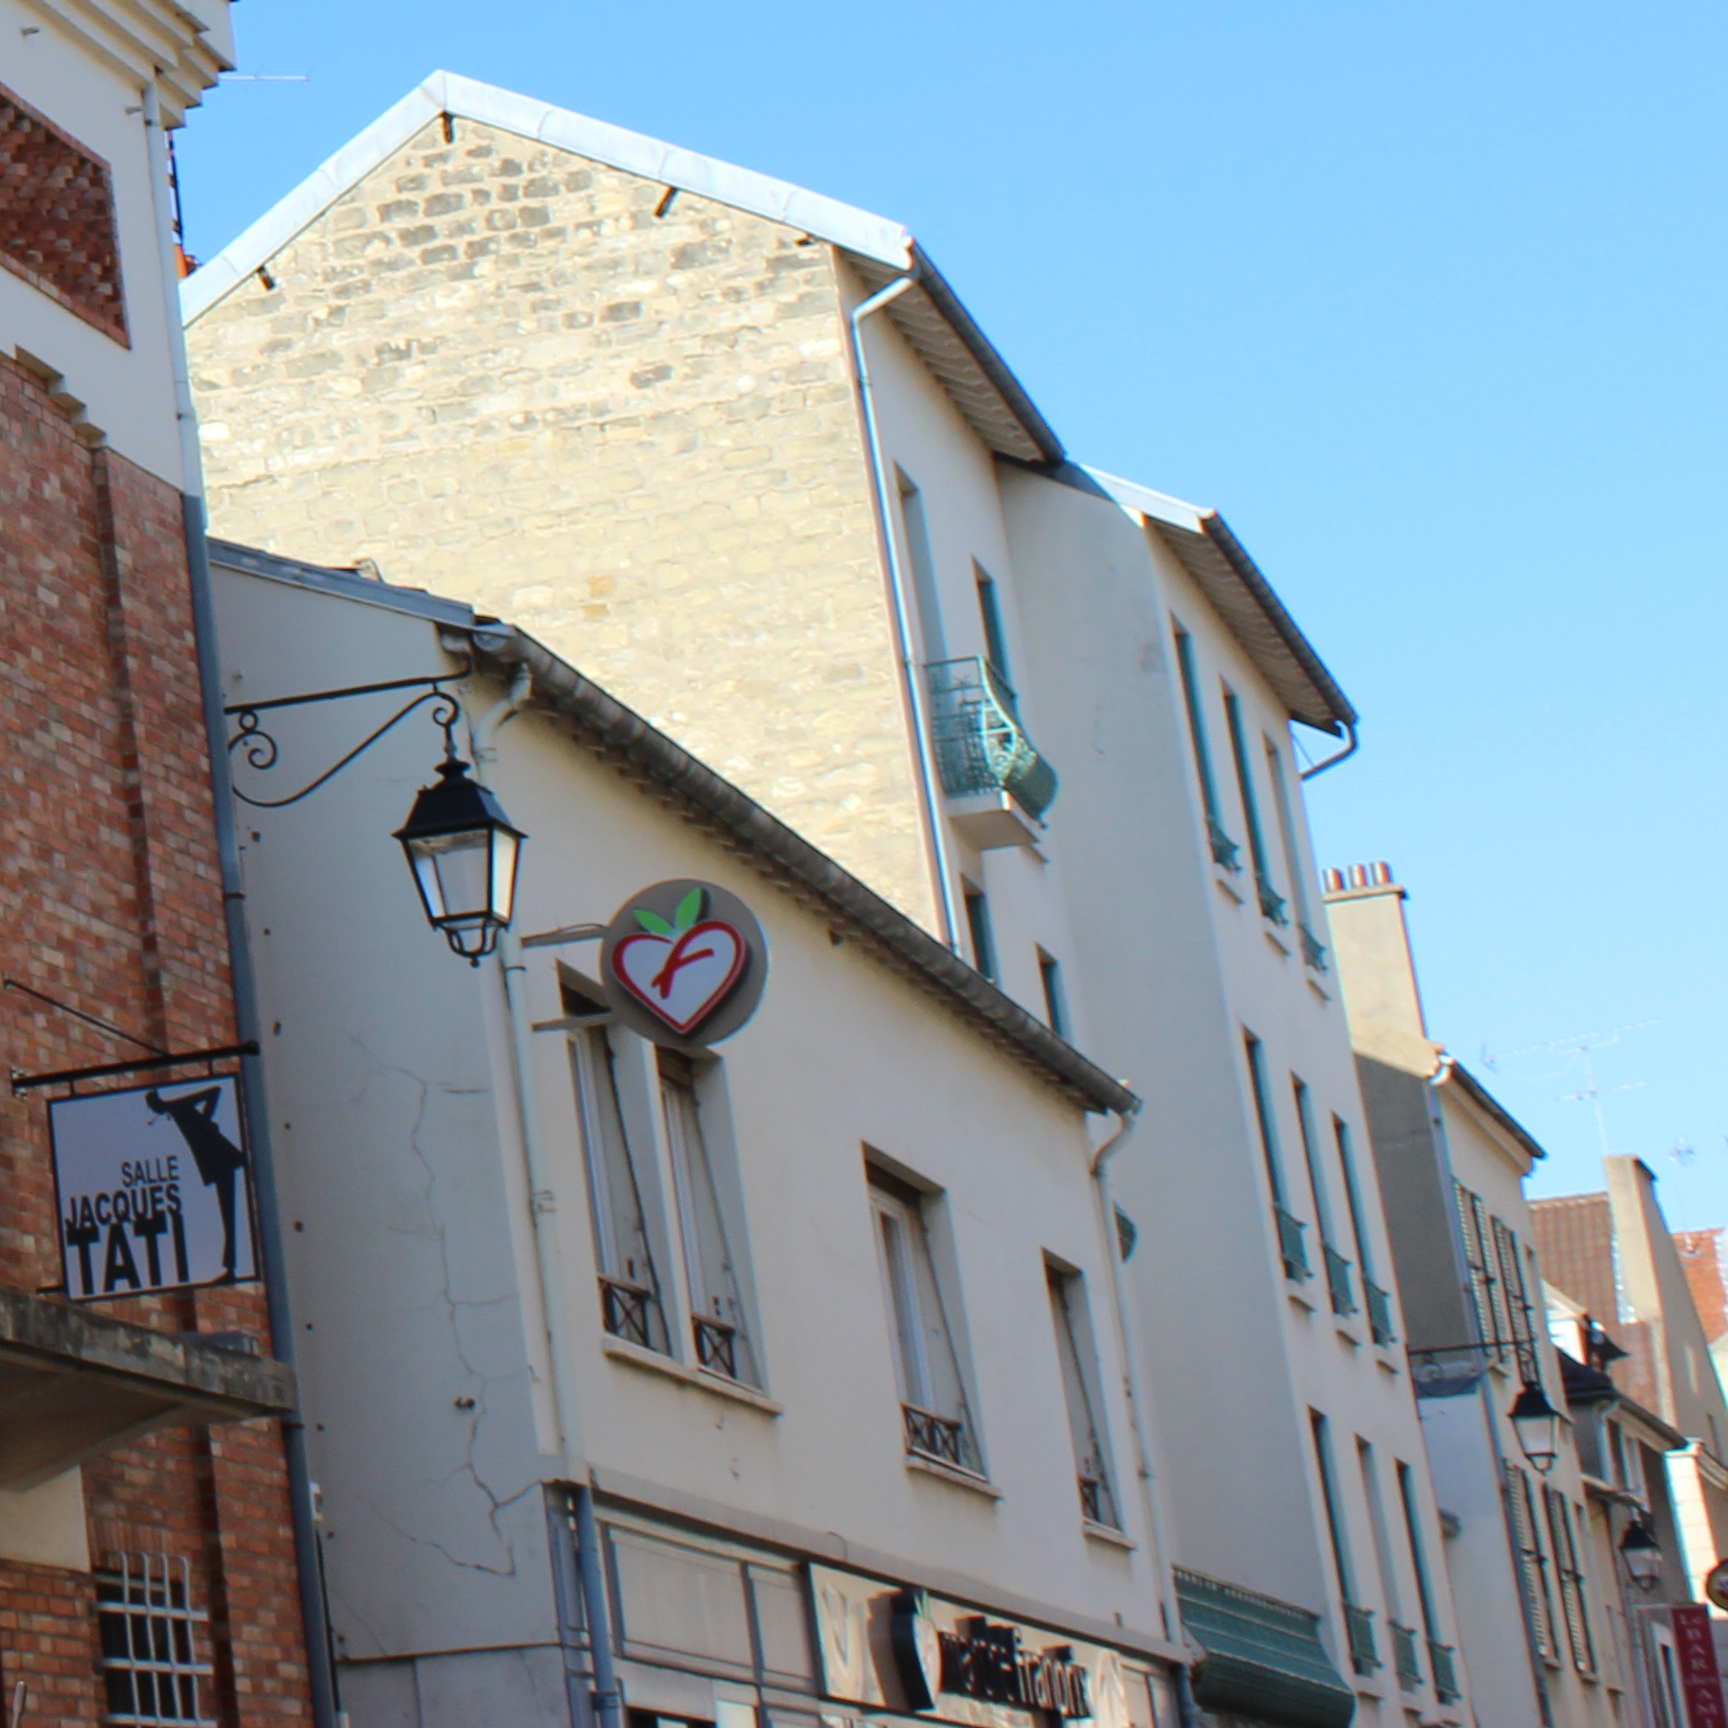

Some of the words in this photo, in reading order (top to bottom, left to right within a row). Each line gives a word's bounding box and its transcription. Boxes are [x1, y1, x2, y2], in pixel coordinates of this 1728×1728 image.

[120, 1155, 181, 1188] SALLE
[64, 1183, 184, 1228] JACQUES
[66, 1210, 190, 1296] TATI
